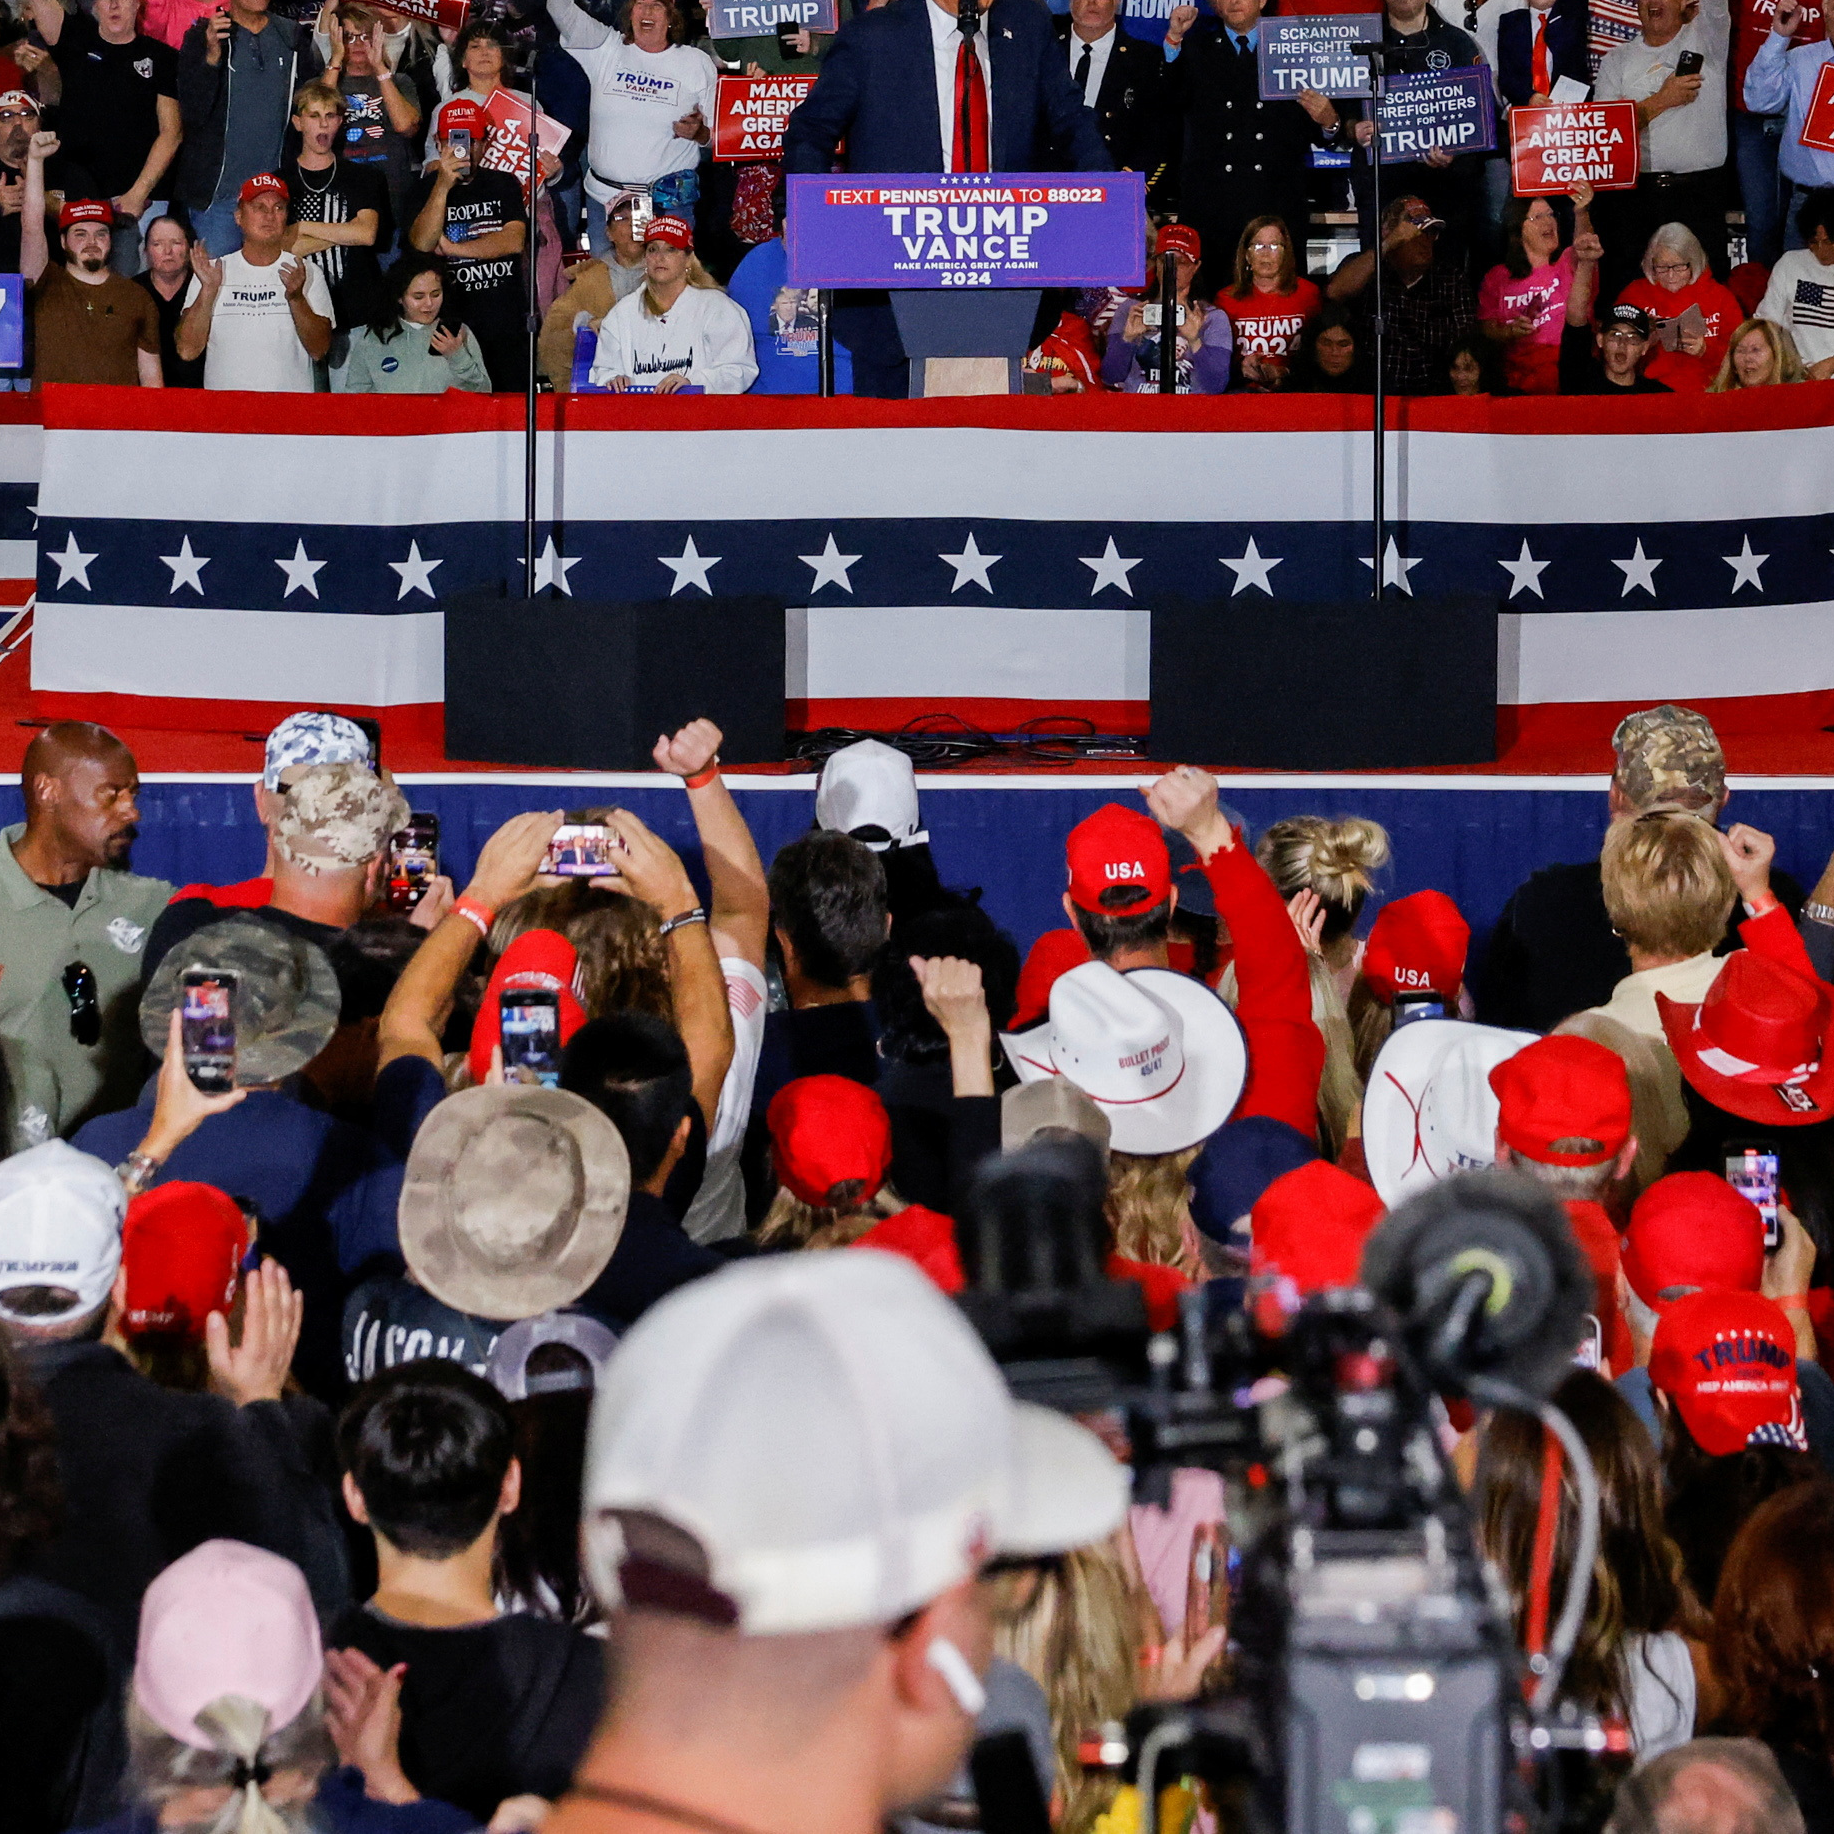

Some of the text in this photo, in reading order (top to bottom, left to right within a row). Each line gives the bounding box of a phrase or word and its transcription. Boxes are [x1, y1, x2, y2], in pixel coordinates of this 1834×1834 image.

[723, 0, 820, 30] TRUMP
[1279, 25, 1360, 41] SCRANTON
[1310, 55, 1330, 64] FOR
[616, 72, 674, 90] TRUMP
[1272, 67, 1370, 90] TRUMP
[626, 83, 658, 95] VANCE
[1384, 86, 1465, 107] SCRANTON
[1416, 115, 1436, 125] FOR
[1545, 111, 1606, 128] MAKE
[1381, 123, 1476, 152] TRUMP
[1527, 128, 1624, 146] AMERICA
[1541, 146, 1612, 164] GREAT
[1540, 163, 1614, 182] AGAIN!
[251, 175, 282, 189] USA
[829, 189, 1102, 203] TEXT PENNSYLVANIA TO 88022
[884, 207, 1048, 236] TRUMP
[902, 236, 1030, 260] VANCE
[893, 261, 1038, 270] MAKE AMERICA GREAT AGAIN!
[941, 272, 992, 285] 2024
[232, 291, 276, 302] TRUMP
[1235, 320, 1303, 336] TRUMP
[1105, 861, 1145, 879] USA
[1395, 967, 1429, 987] USA
